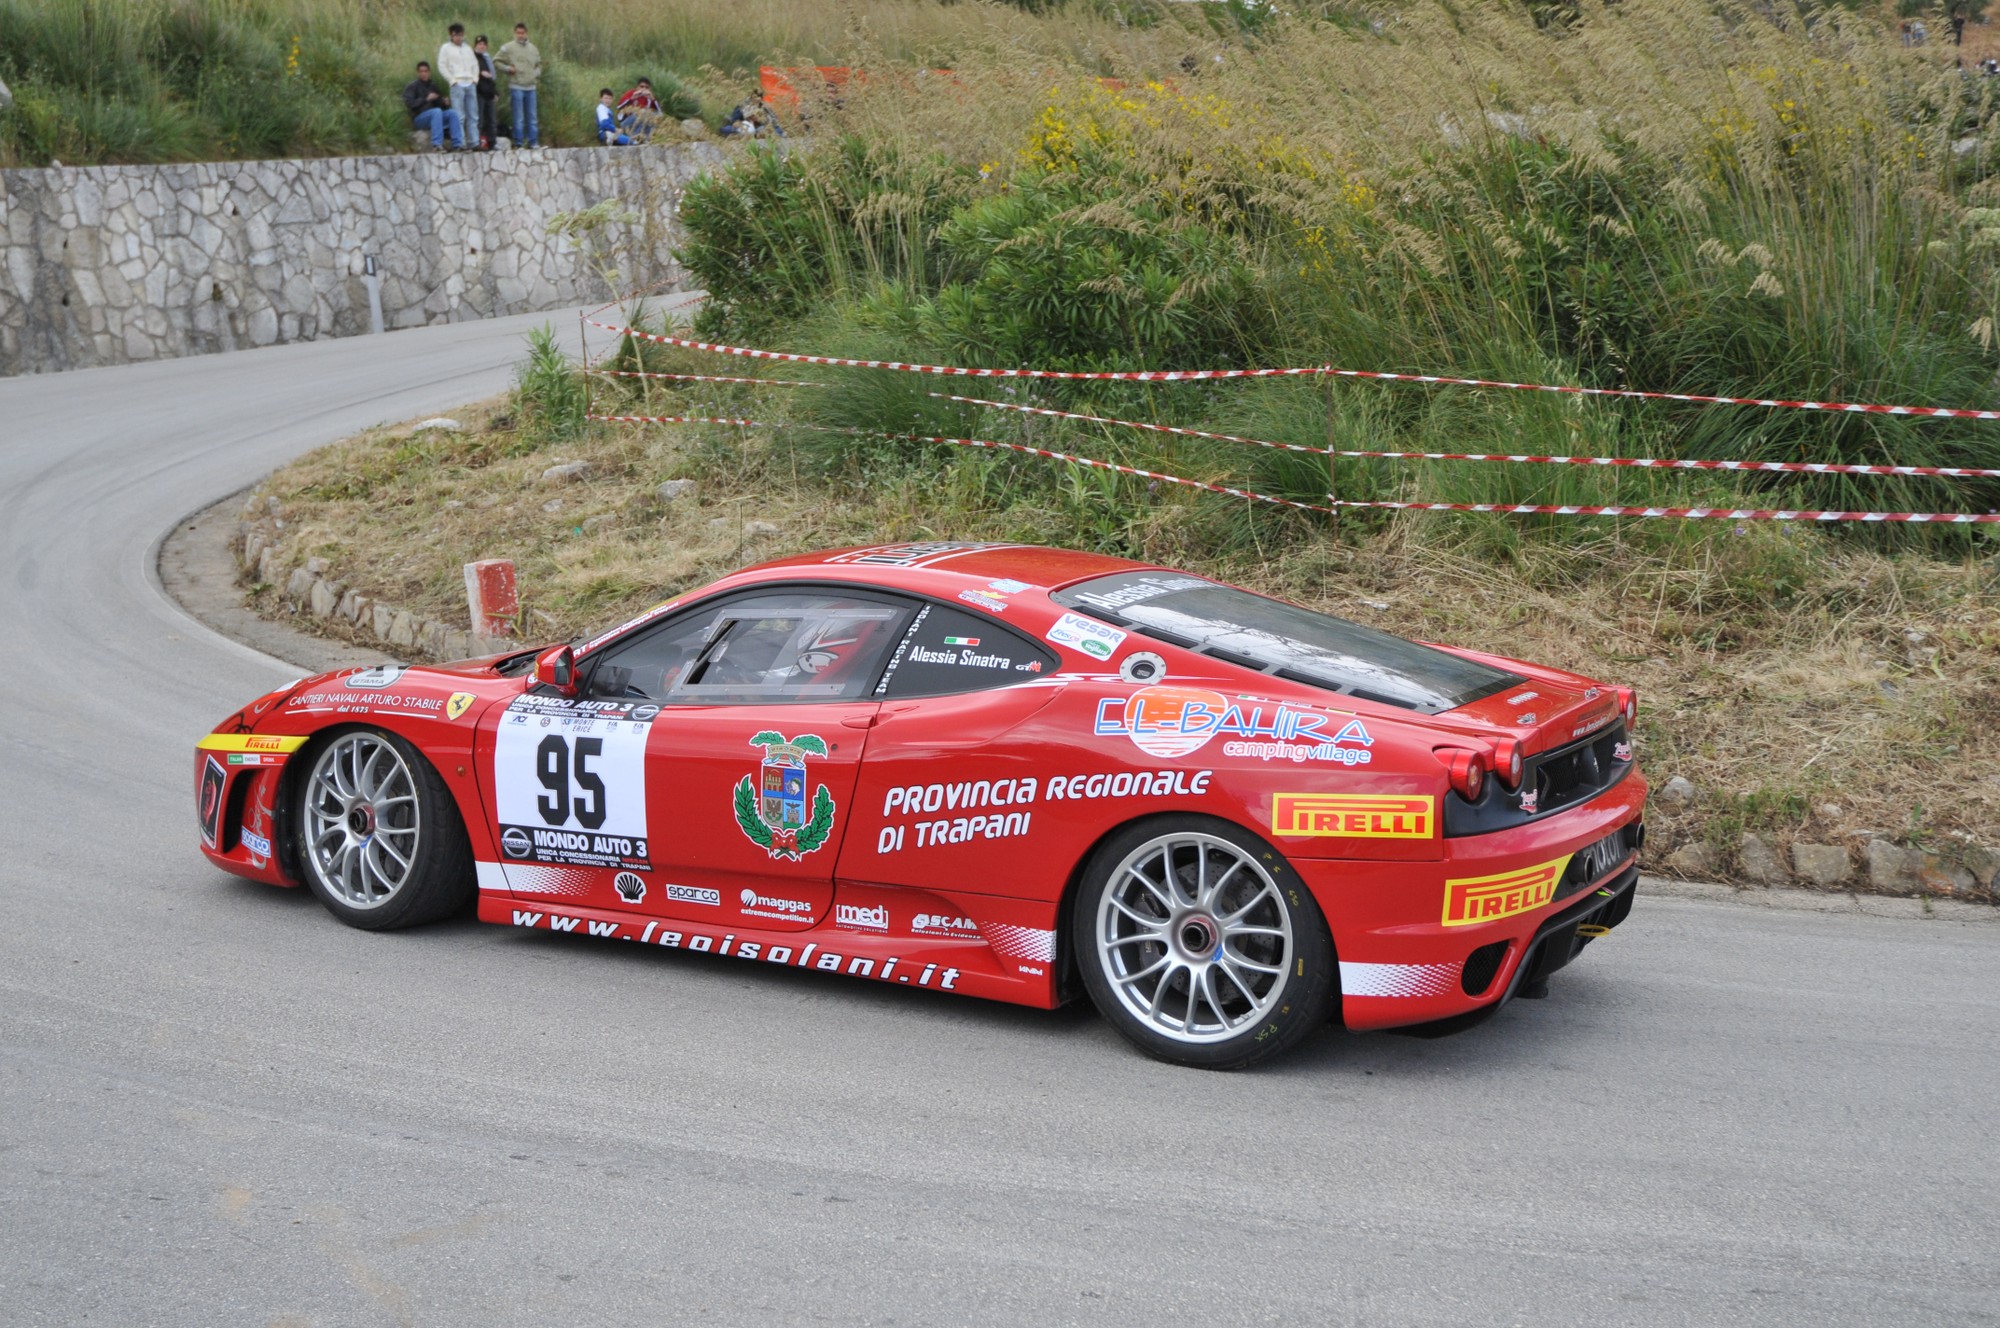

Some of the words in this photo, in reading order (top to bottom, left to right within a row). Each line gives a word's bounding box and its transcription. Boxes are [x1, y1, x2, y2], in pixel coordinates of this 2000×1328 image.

[909, 645, 957, 665] Alessia
[959, 650, 1011, 670] Sinatra
[875, 672, 893, 694] TEAM
[289, 694, 325, 706] CANTIERI
[325, 693, 359, 703] NAVALI
[359, 694, 402, 706] ARTURO
[403, 697, 443, 711] STABILE
[337, 705, 349, 713] dal
[515, 693, 575, 708] MONDO
[575, 700, 619, 711] AUTO
[619, 703, 634, 712] 3
[535, 705, 597, 714] CONCESSIONARIA
[572, 725, 592, 733] ERICE
[245, 737, 281, 749] PIRELLI
[537, 734, 607, 830] 95
[883, 777, 1038, 817] PROVINCIA
[1045, 770, 1214, 801] REGIONALE
[1277, 797, 1429, 834] PIRELLI
[877, 825, 905, 854] DI
[914, 811, 1032, 848] TRAPANI
[503, 839, 530, 848] NISSAN
[533, 830, 589, 851] MONDO
[594, 837, 632, 856] AUTO
[636, 840, 648, 858] 3
[536, 848, 558, 856] UNICA
[559, 850, 621, 863] CONCESSIONARIA
[568, 858, 606, 867] PROVINCIA
[621, 862, 652, 871] TRAPANI
[668, 885, 719, 902] sparco
[1448, 865, 1556, 921] PIRELLI
[757, 896, 811, 912] magigas
[740, 908, 814, 924] extremecompetition.it
